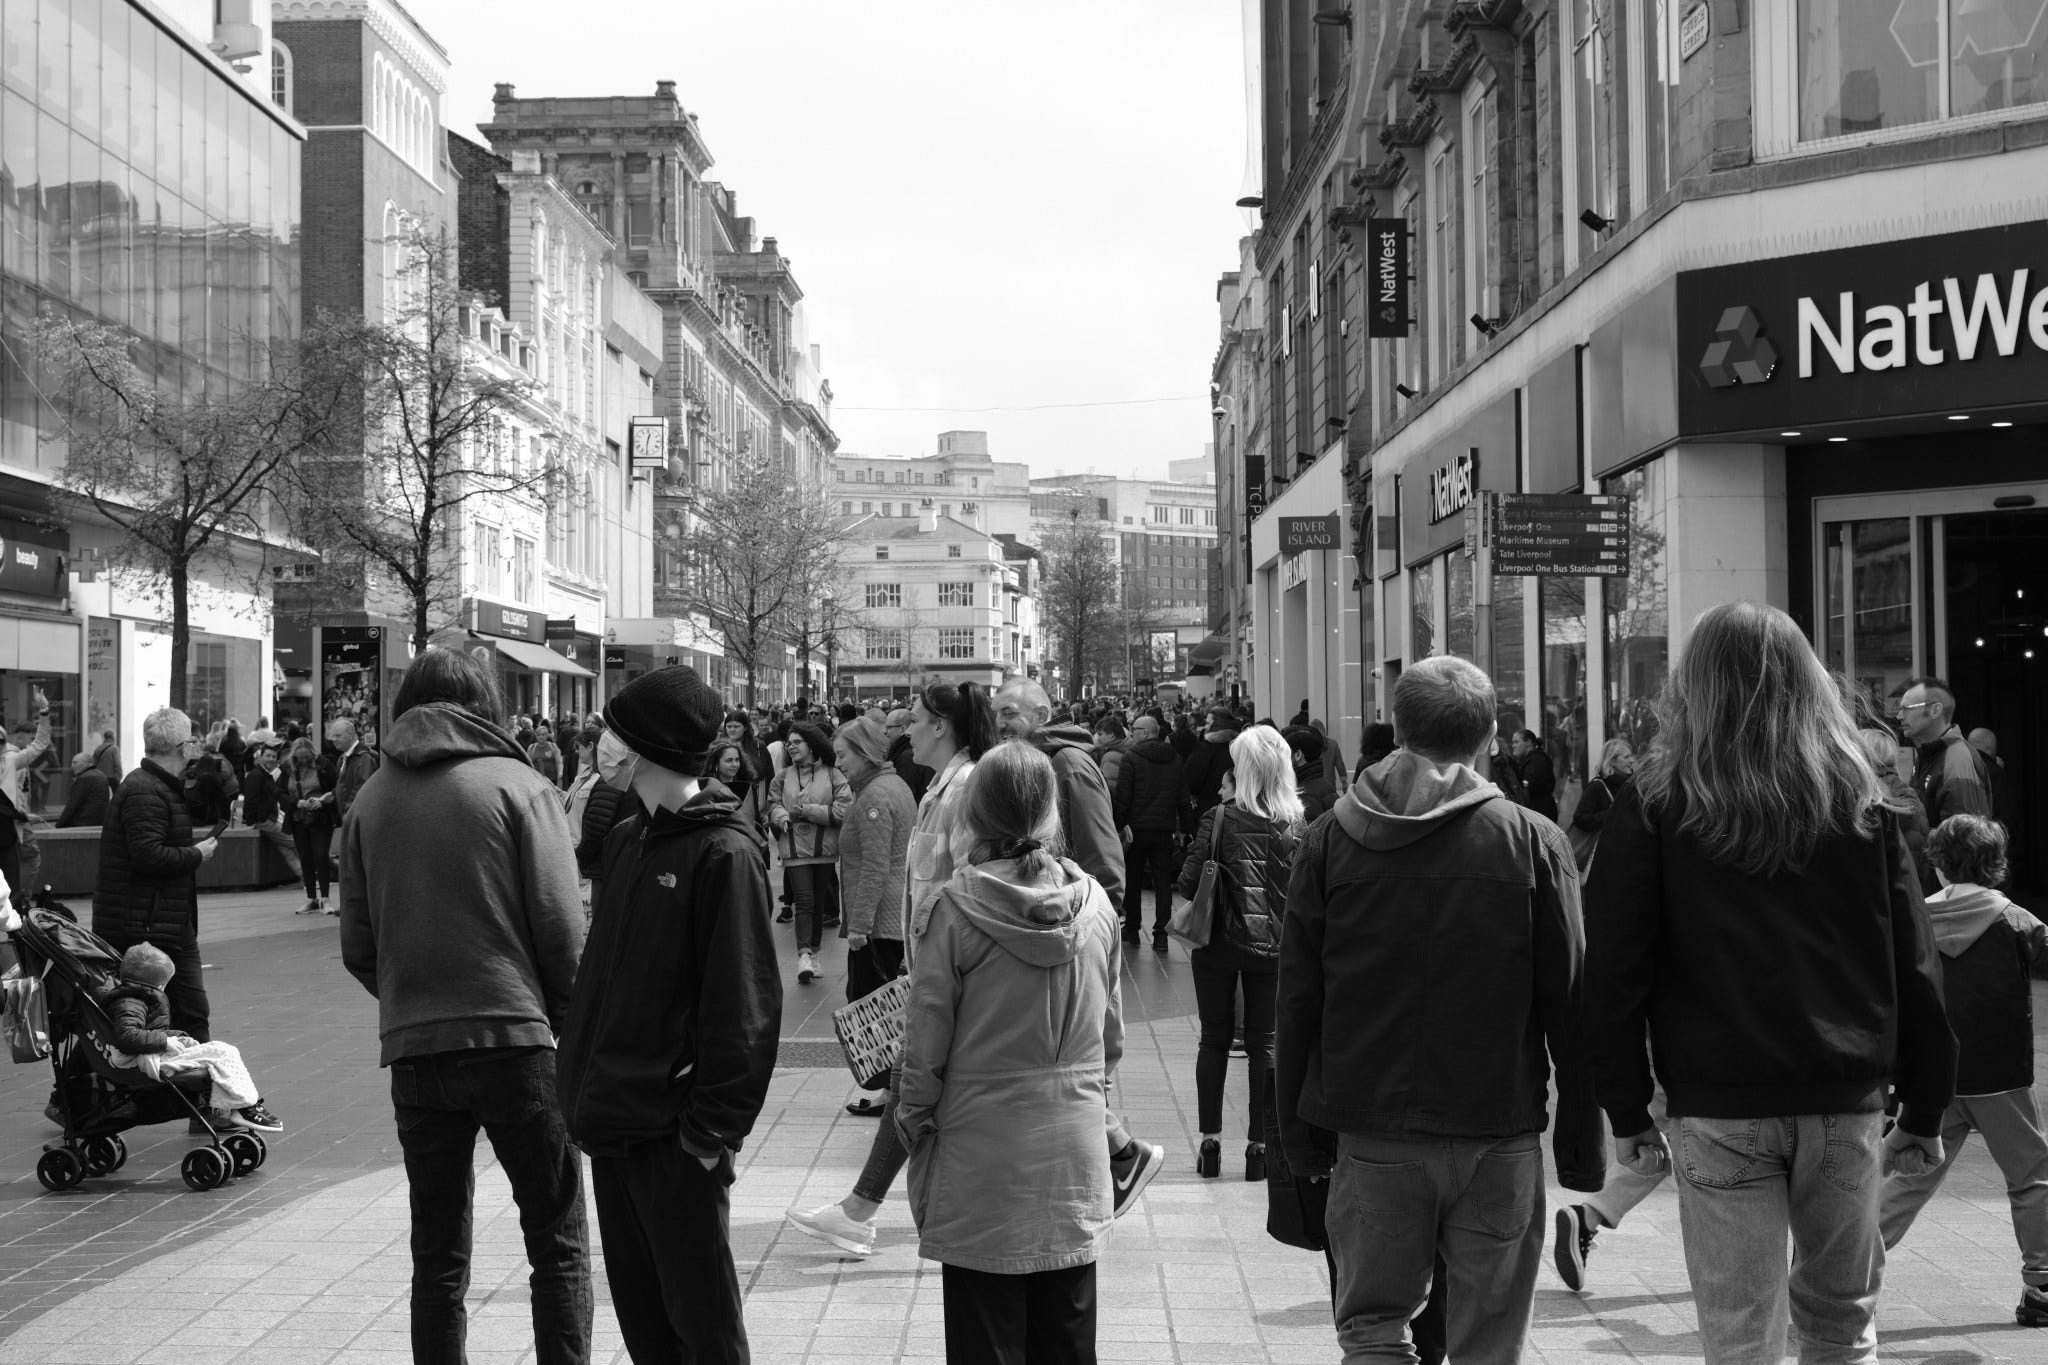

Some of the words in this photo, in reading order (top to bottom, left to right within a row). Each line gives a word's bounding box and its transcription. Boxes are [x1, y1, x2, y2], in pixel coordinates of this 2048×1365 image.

[1380, 232, 1396, 302] NatWest
[1434, 448, 1473, 521] NatWest
[1292, 522, 1326, 532] RIVER
[1536, 523, 1551, 531] One
[1288, 534, 1331, 545] ISLAND
[1500, 536, 1534, 545] Maritime
[1536, 537, 1569, 545] Museum
[1500, 550, 1515, 558] Tate
[1517, 550, 1551, 559] Liverpool
[1499, 563, 1533, 573] Liverpool
[1536, 564, 1551, 572] One
[1553, 564, 1568, 573] Bus
[1570, 563, 1597, 573] Station
